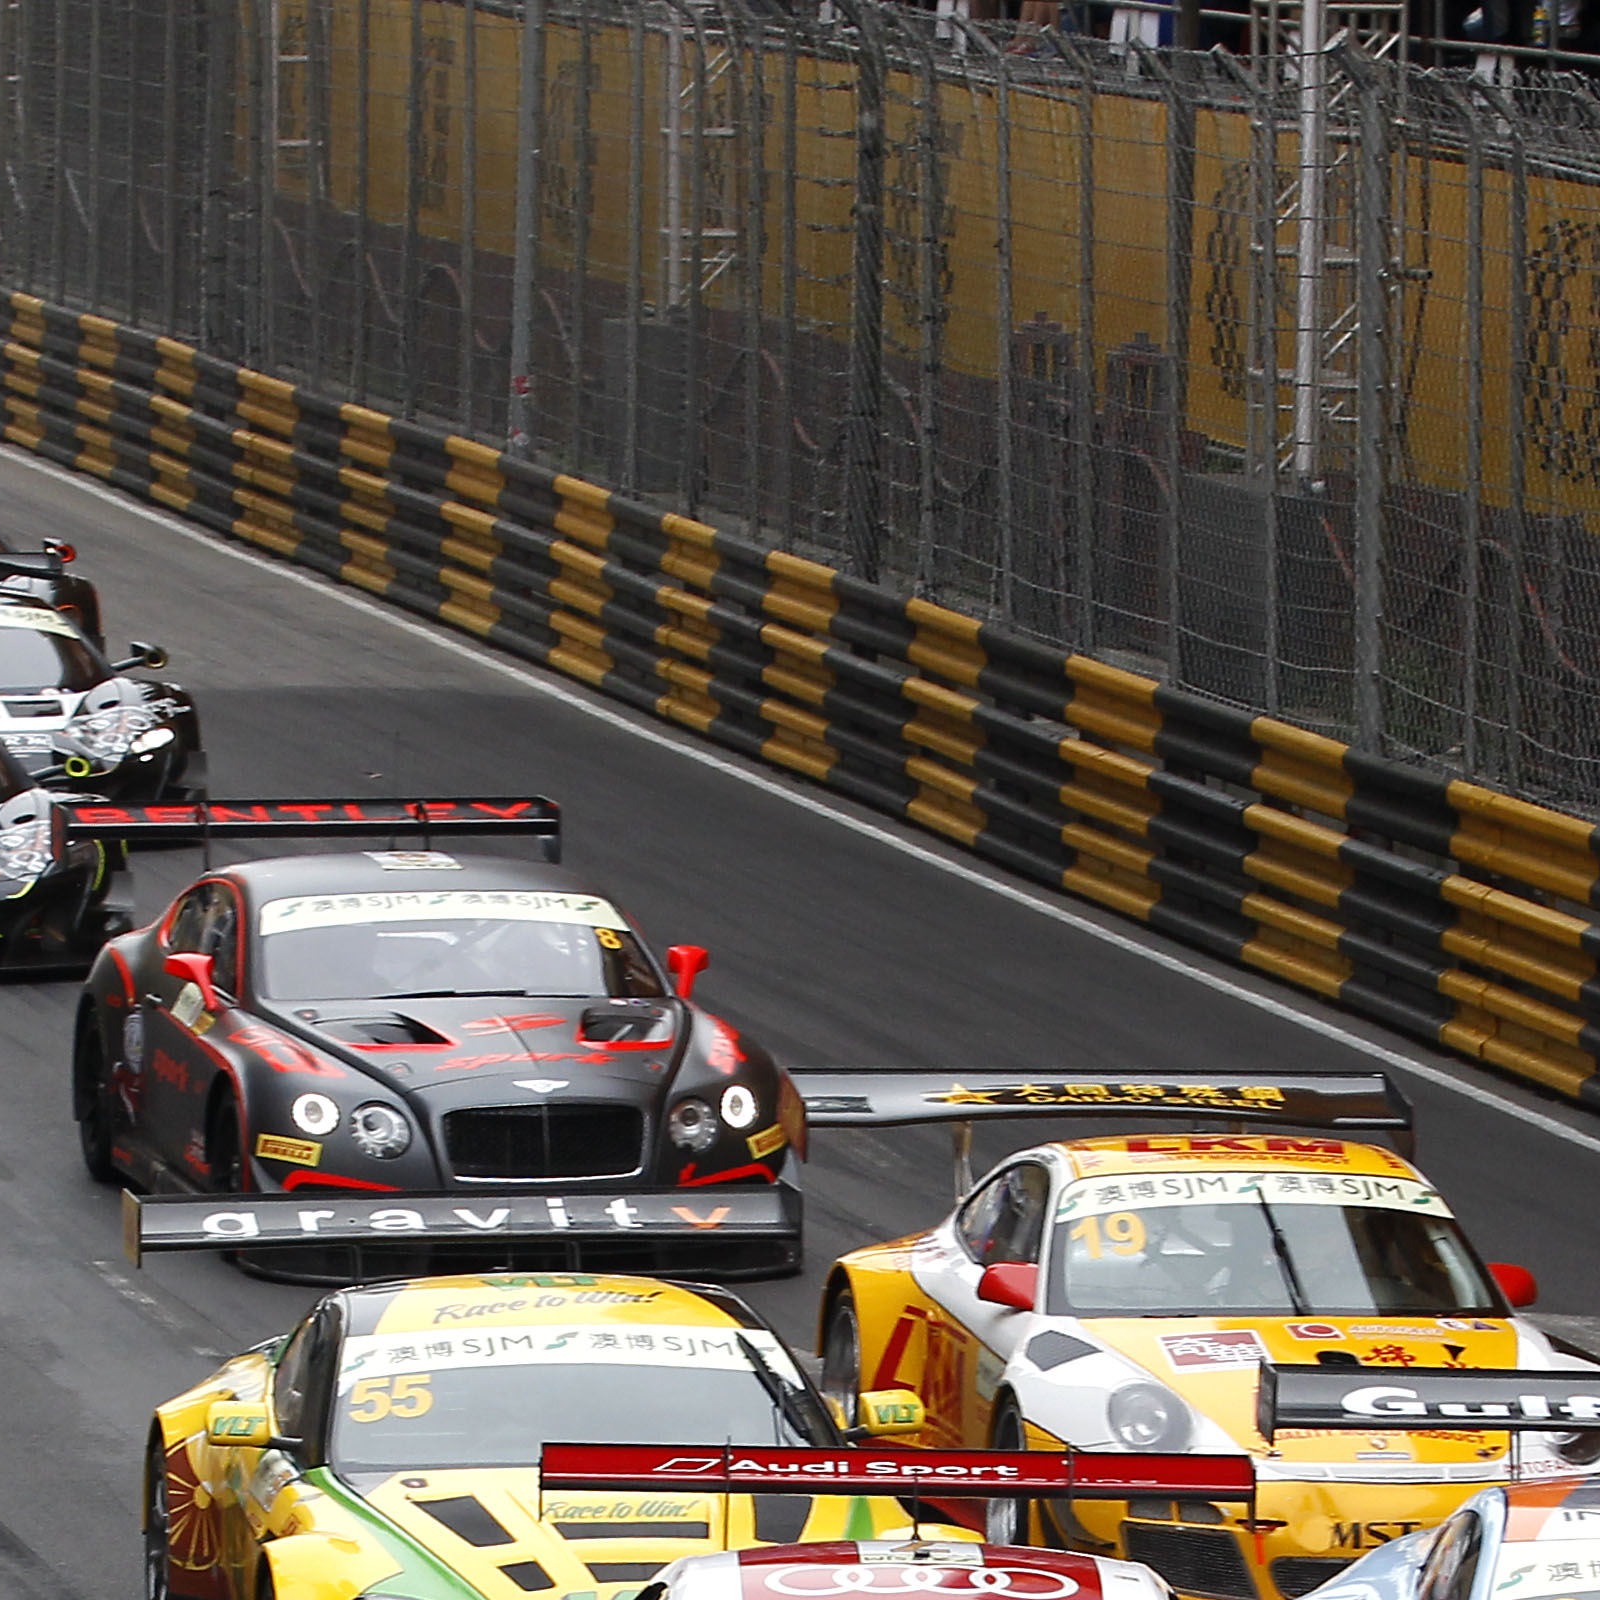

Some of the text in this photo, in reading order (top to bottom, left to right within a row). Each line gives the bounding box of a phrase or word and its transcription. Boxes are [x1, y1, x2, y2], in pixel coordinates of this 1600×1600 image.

[74, 802, 533, 824] BENTLEY
[594, 927, 623, 950] 8
[1127, 1138, 1345, 1154] LKM
[1068, 1211, 1149, 1261] 19
[431, 1290, 666, 1325] Race to Win!
[462, 1333, 535, 1357] SJM
[347, 1373, 435, 1424] 55
[873, 1403, 918, 1424] VLT
[213, 1416, 266, 1437] VLT
[727, 1458, 1019, 1477] Audi Sport
[542, 1499, 700, 1518] Race to Win!
